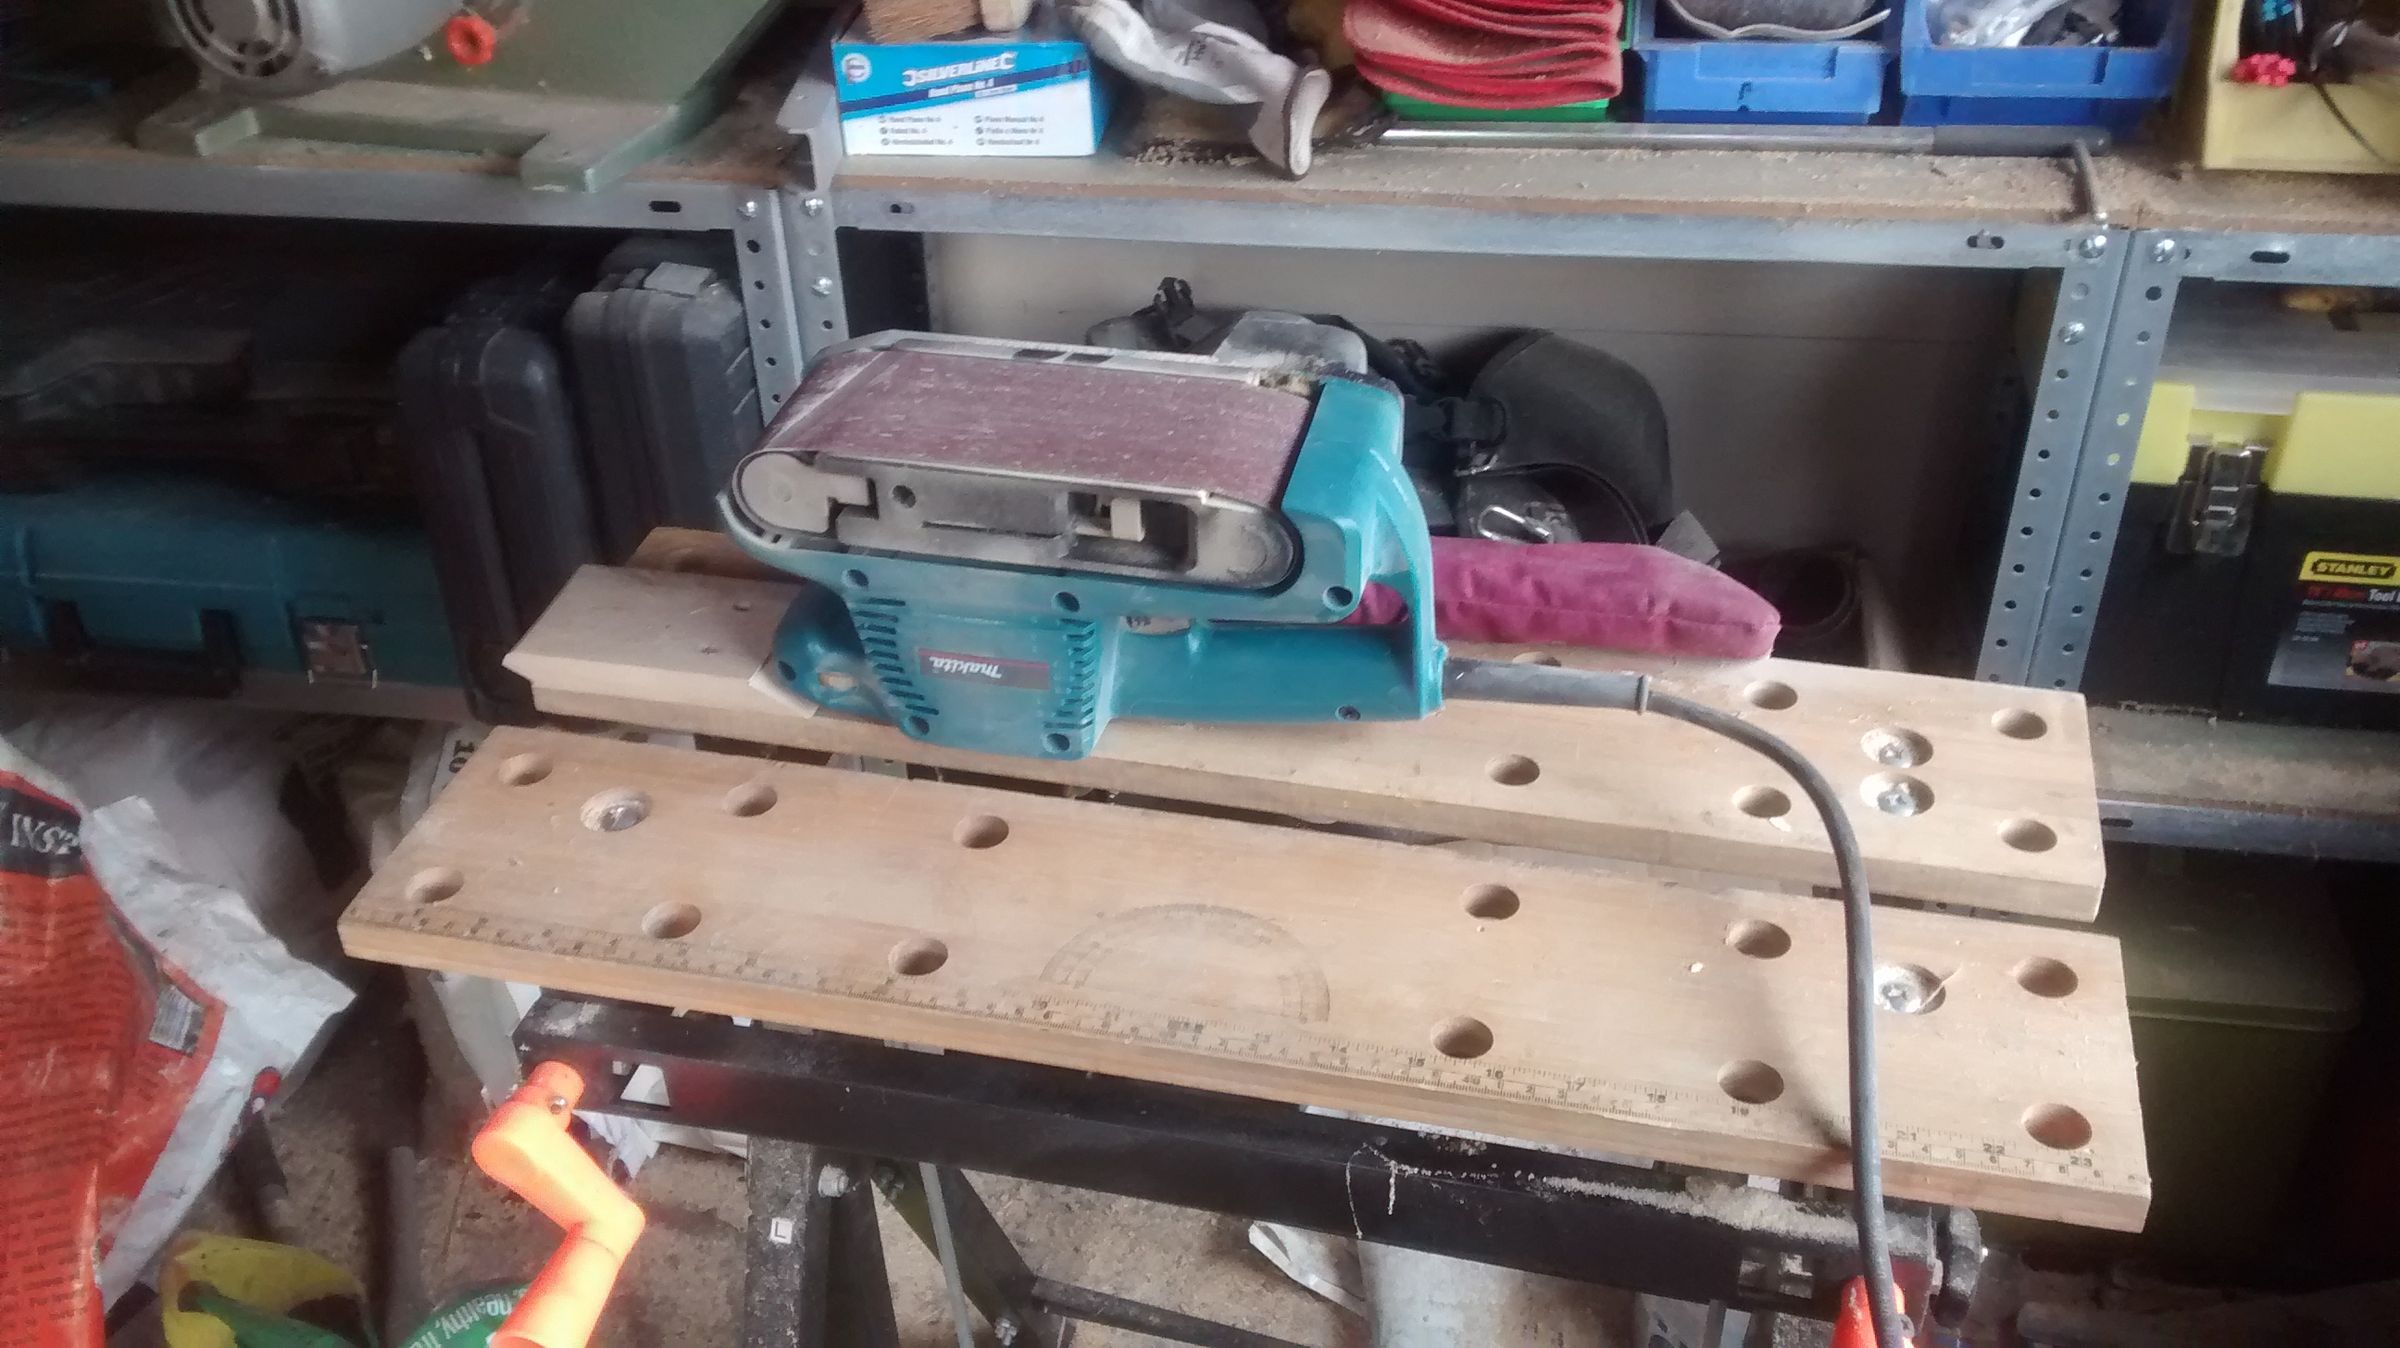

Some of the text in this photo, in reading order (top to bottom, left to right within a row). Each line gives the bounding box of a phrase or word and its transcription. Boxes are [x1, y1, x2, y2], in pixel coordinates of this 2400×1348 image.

[914, 55, 1004, 83] SILVERLINE
[2316, 560, 2390, 576] STANLEY
[2368, 588, 2396, 602] Tool
[774, 1221, 787, 1239] L
